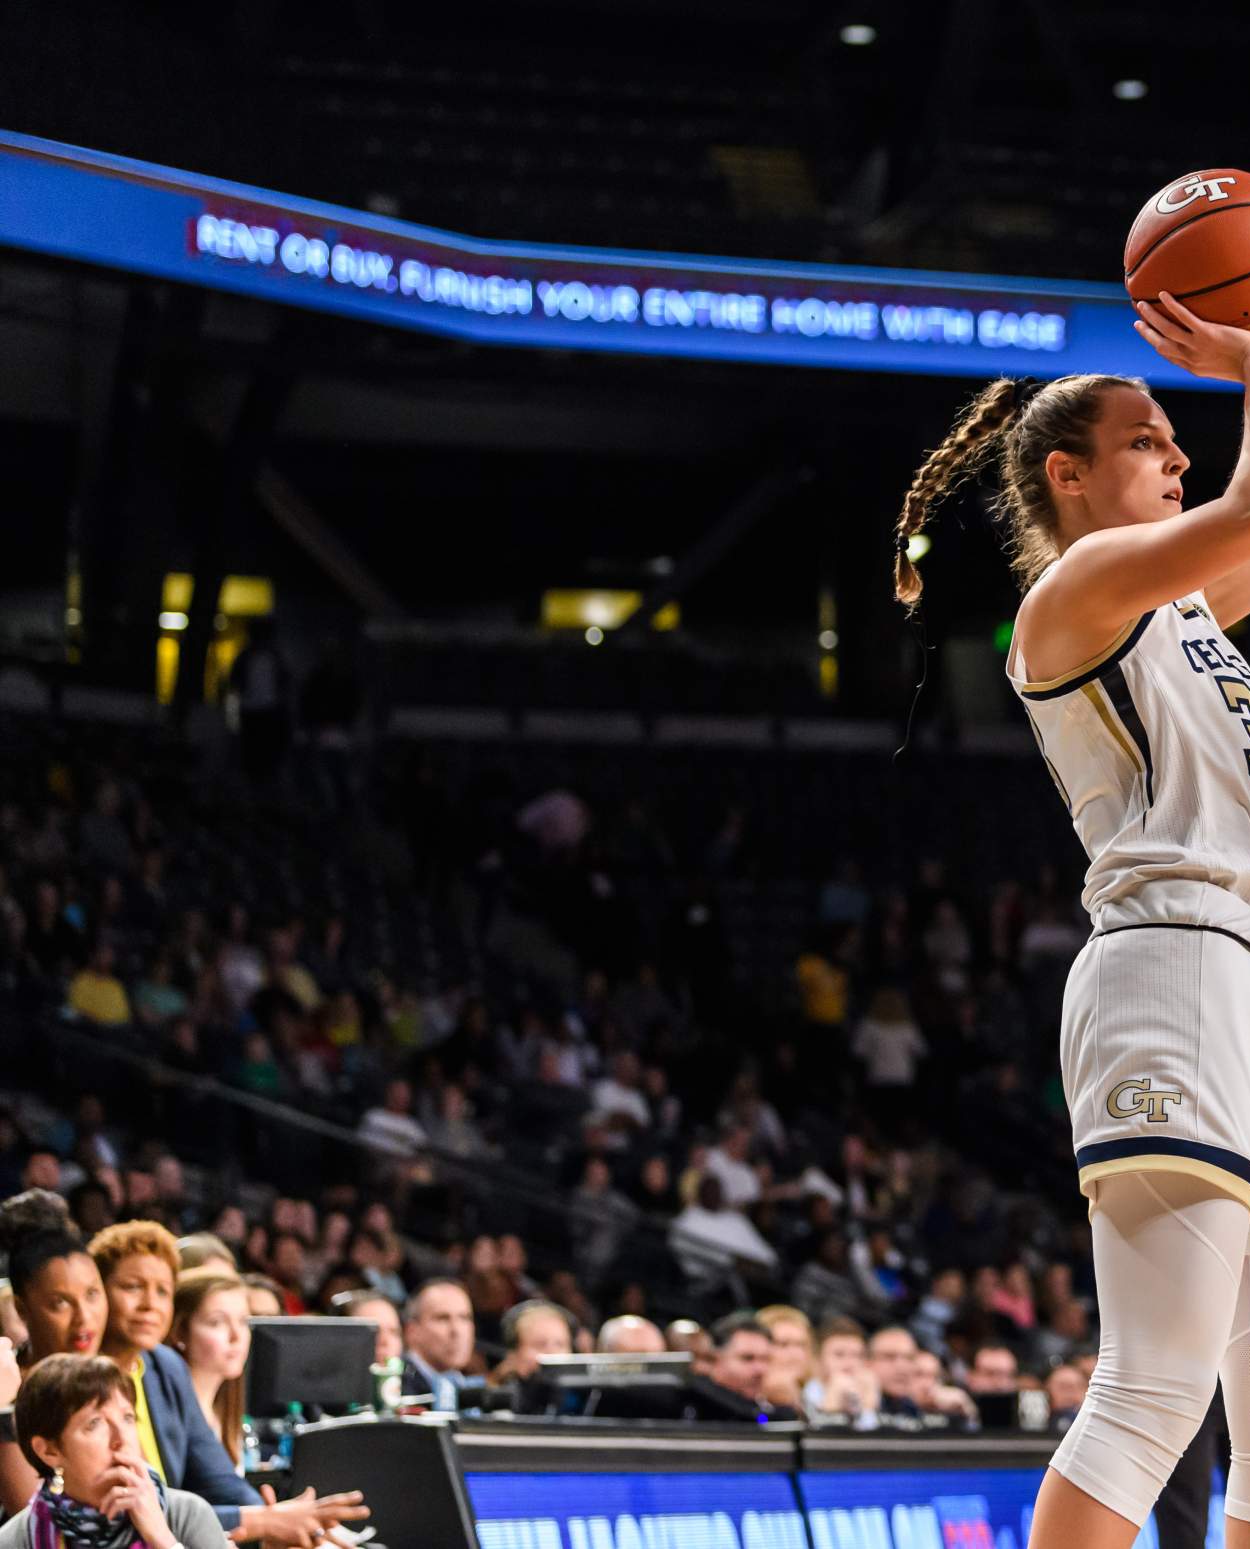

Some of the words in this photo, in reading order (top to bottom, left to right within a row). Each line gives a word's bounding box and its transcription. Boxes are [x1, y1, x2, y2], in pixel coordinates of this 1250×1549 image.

[1156, 175, 1236, 214] GT
[197, 214, 279, 264] RENT
[280, 233, 329, 278] OR
[400, 259, 532, 315] FURNISH
[537, 281, 640, 322] YOUR
[642, 287, 766, 333] ENTIRE
[772, 298, 878, 340] HOME
[881, 305, 973, 344] WITH
[977, 310, 1066, 351] EASE
[1107, 1078, 1182, 1123] GT
